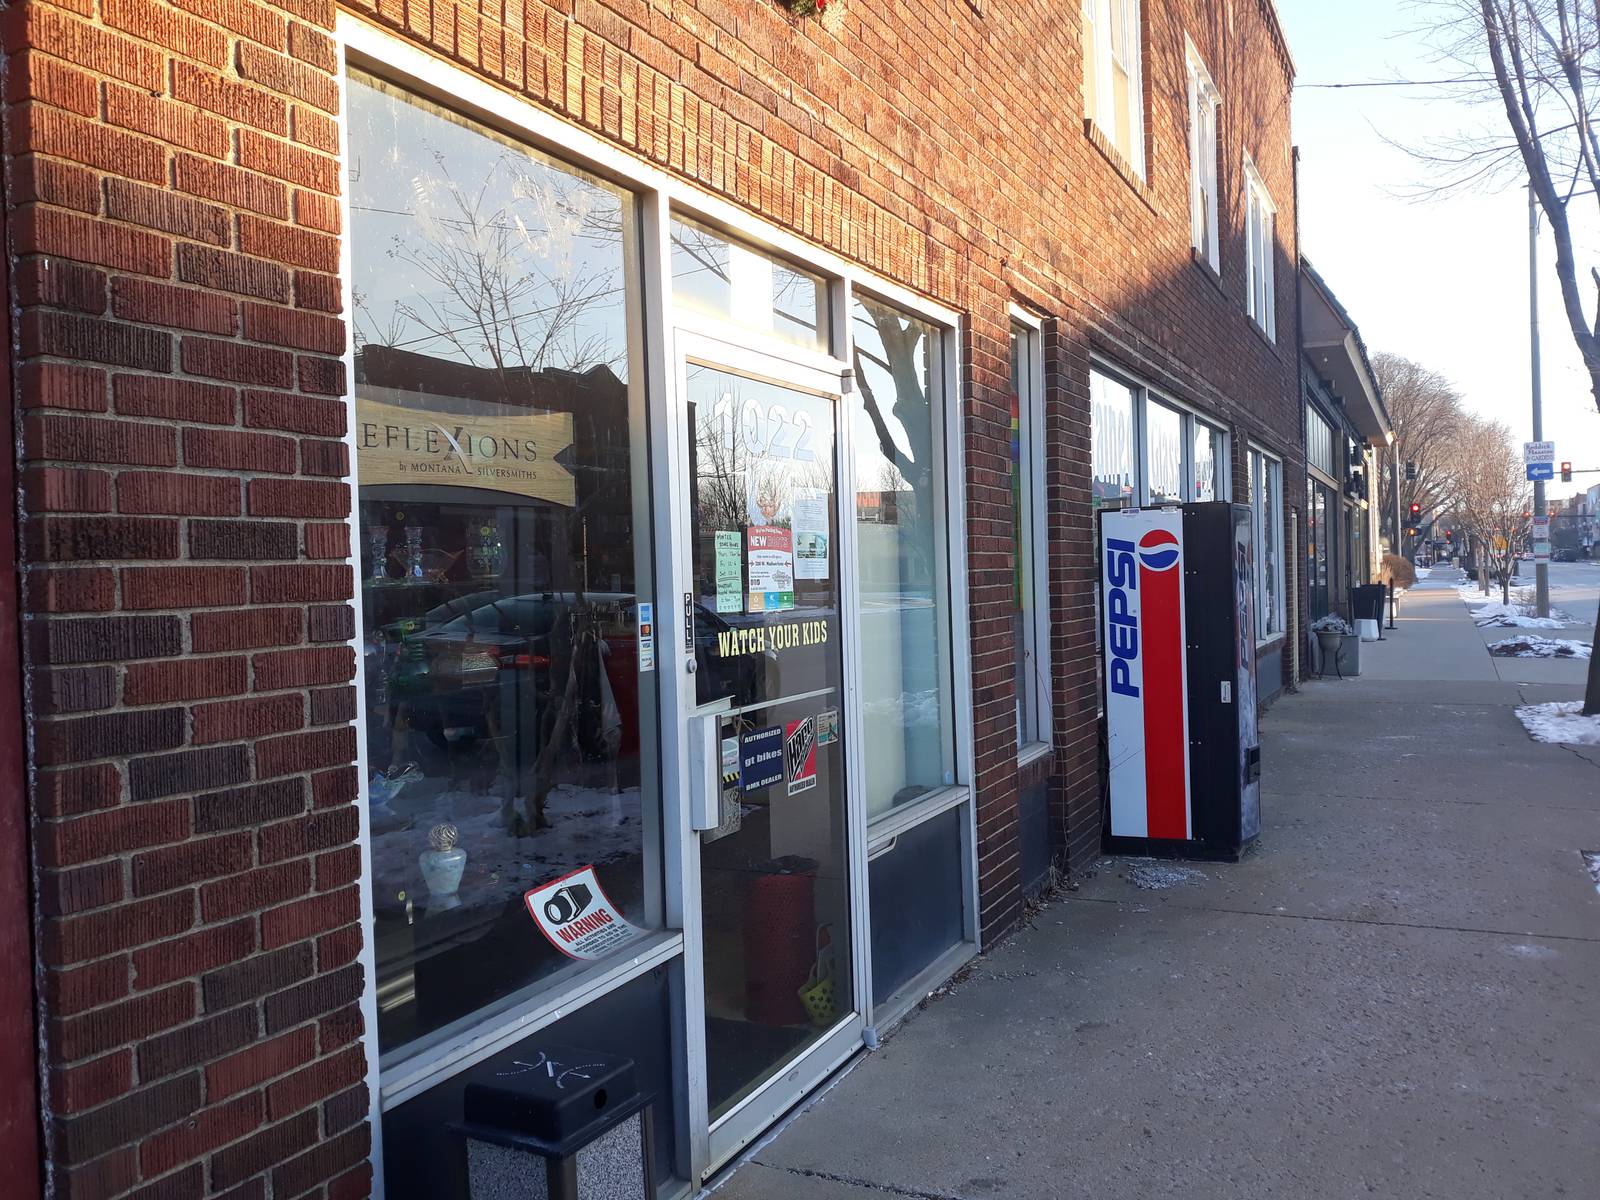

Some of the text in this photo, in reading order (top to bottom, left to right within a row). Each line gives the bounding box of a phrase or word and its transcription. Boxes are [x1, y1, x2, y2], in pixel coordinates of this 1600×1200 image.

[713, 392, 815, 462] 1022
[356, 421, 538, 463] EFLEXIONS
[399, 460, 537, 480] by MONTANA SILVERSMITHS
[750, 536, 766, 546] NEW
[1107, 538, 1139, 698] PEPSI
[718, 627, 765, 658] WATCH
[768, 622, 800, 650] YOUR
[802, 620, 828, 645] KIDS
[744, 728, 782, 744] AUTHORIZED
[744, 748, 782, 768] gt bikes
[746, 774, 782, 791] BMX DEALER
[556, 908, 614, 944] WARNING
[575, 938, 584, 946] ALL
[584, 928, 608, 942] ACTIVITIES
[584, 937, 614, 953] PROSECUTION
